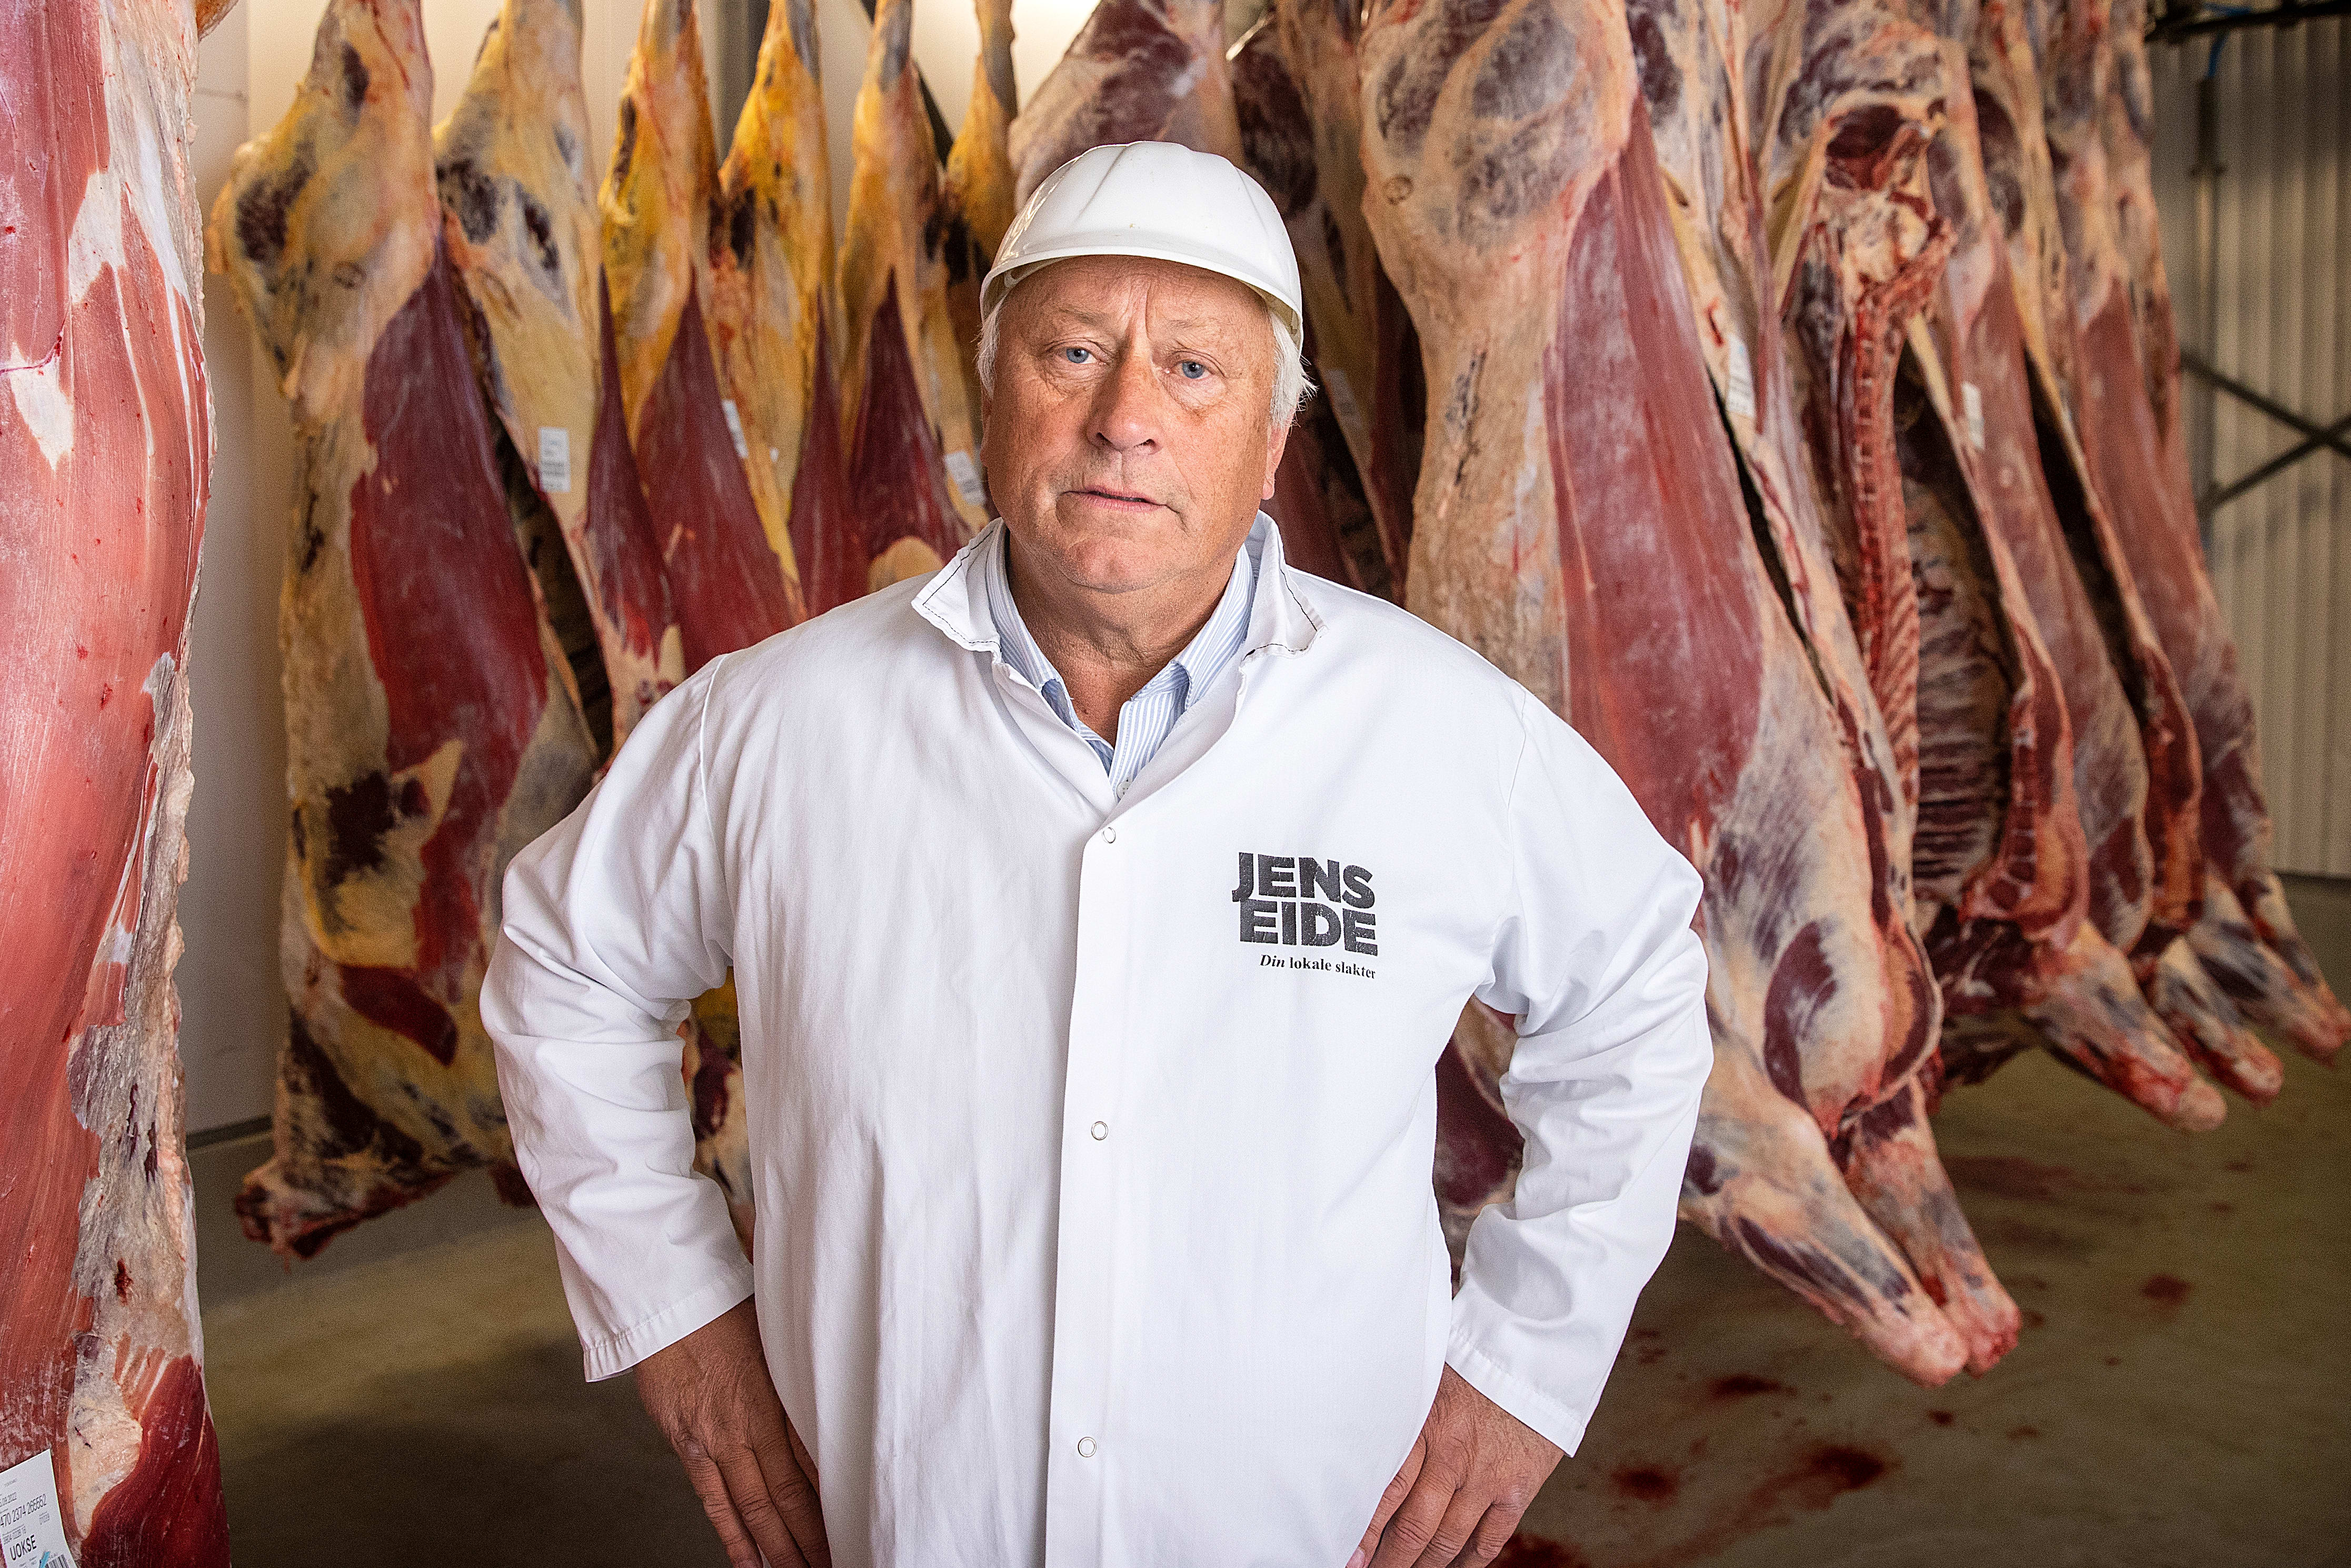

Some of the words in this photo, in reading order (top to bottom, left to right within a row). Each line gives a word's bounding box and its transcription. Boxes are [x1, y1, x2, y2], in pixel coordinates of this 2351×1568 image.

[1232, 852, 1376, 909] JENS
[1240, 898, 1378, 956] EIDE
[1260, 954, 1285, 967] Din
[1289, 956, 1332, 971] lokale
[1335, 961, 1376, 979] slakter
[12, 1505, 26, 1522] 2374
[10, 1534, 37, 1561] UOKSE
